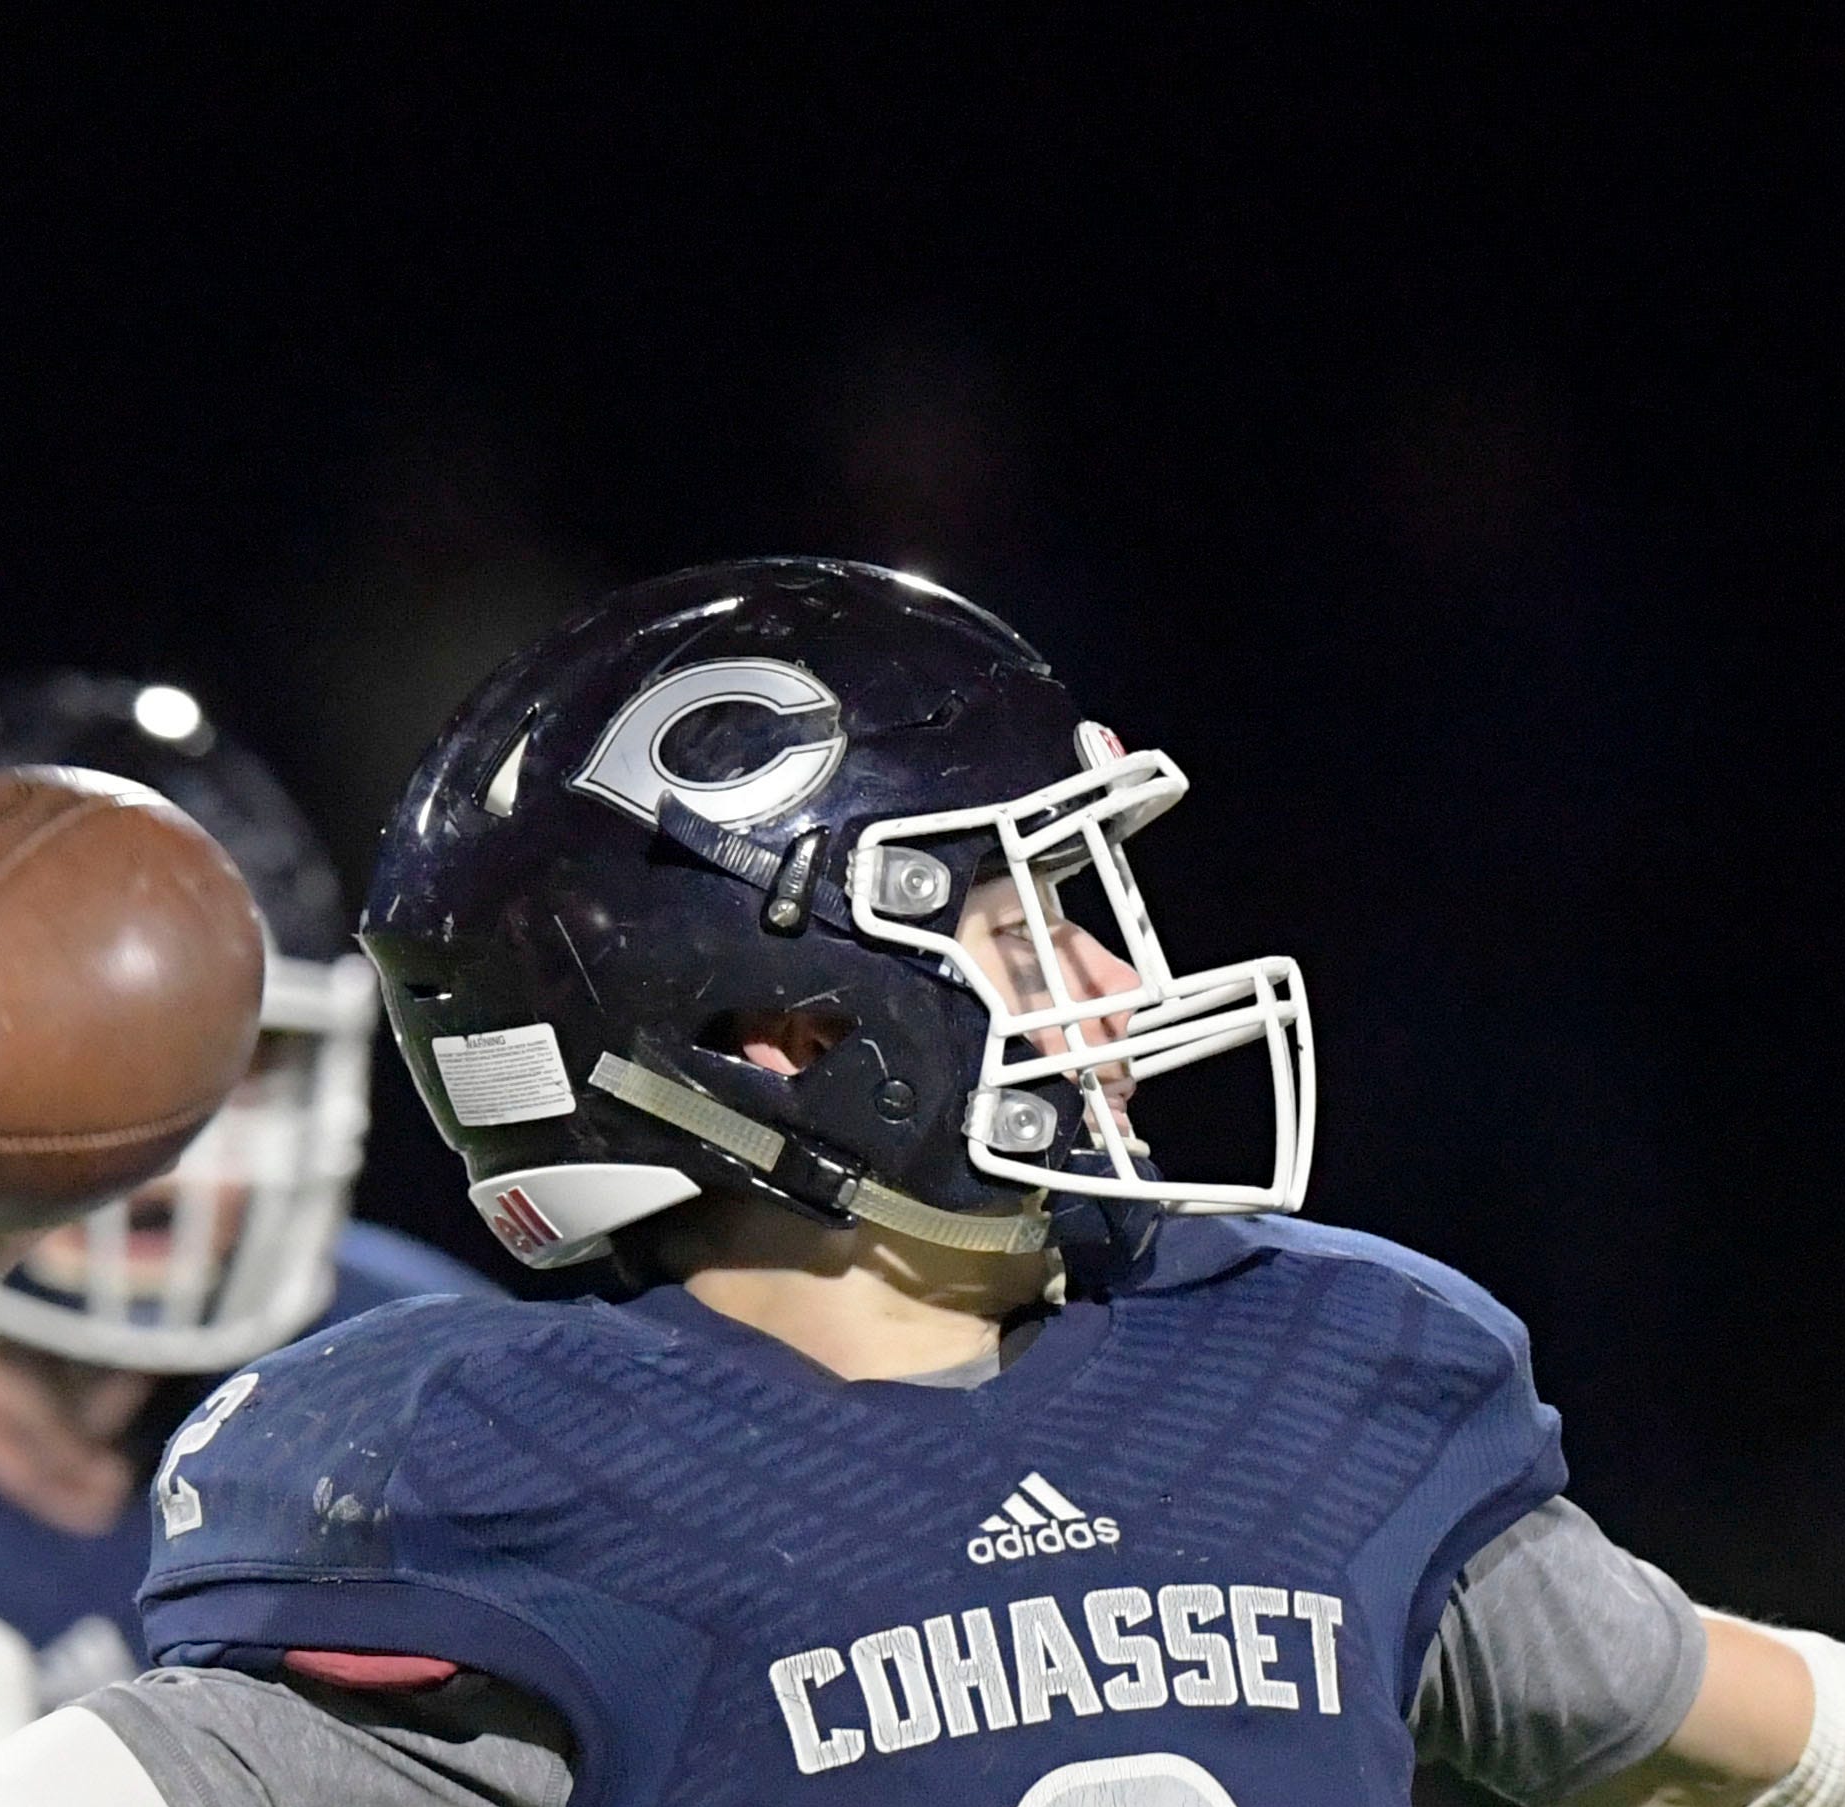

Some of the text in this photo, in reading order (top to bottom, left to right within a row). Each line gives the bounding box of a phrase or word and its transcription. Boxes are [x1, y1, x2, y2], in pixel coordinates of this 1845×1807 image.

[567, 656, 847, 830] C
[157, 1371, 260, 1540] 2
[967, 1515, 1121, 1564] adidas
[768, 1584, 1343, 1775] COHASSET
